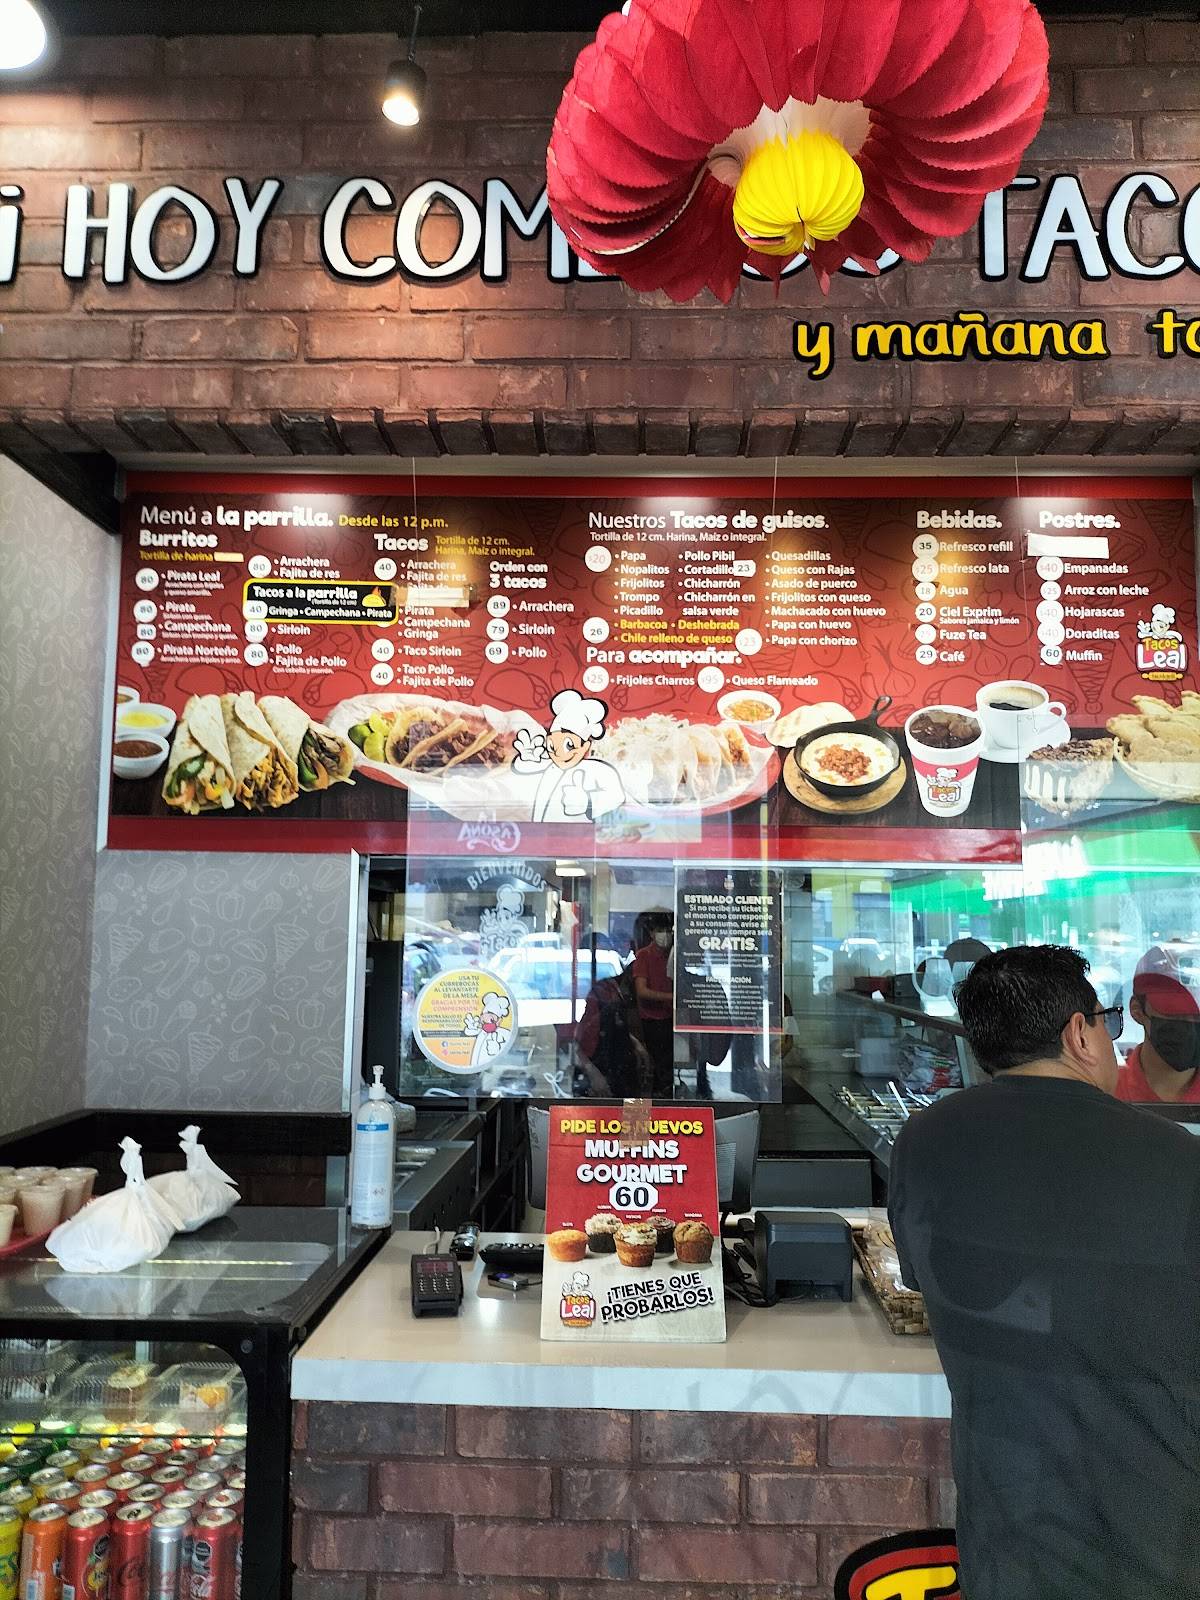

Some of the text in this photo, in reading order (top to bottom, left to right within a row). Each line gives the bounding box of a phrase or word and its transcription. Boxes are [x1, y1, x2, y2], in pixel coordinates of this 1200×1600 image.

[64, 182, 283, 284] HOY
[794, 320, 834, 380] y
[853, 311, 1108, 360] mañana
[140, 506, 448, 531] Menú a la parrilla. Desde las 12 p.m.
[588, 510, 829, 533] Nuestros Tacos de guisos.
[916, 510, 1002, 529] Bebidas.
[1039, 511, 1121, 529] Postres.
[139, 529, 218, 548] Burritos
[374, 533, 428, 551] Tacos
[919, 542, 931, 550] 35
[939, 540, 1013, 552] Refresco refill
[280, 556, 330, 567] Arrachera
[621, 551, 646, 562] Papa
[684, 551, 735, 561] Pollo Pibil
[772, 551, 831, 561] Quesadillas
[407, 559, 456, 571] Arrachera
[490, 561, 548, 573] Orden con
[620, 565, 670, 575] Nopalitos
[684, 565, 734, 575] Cortadillo
[738, 564, 750, 572] 23
[772, 565, 855, 576] Queso con Rajas
[939, 563, 1009, 574] Refresco lata
[1064, 562, 1128, 575] Empanadas
[167, 570, 221, 582] Pirata Leal
[279, 568, 340, 579] Fajita de res
[407, 571, 466, 583] Fajita de res
[490, 574, 547, 588] 3 tacos
[620, 578, 665, 590] Frijolitos
[684, 578, 740, 588] Chicharrón
[772, 579, 857, 590] Asado de puerco
[253, 587, 284, 598] Tacos
[286, 589, 293, 598] a
[295, 587, 306, 598] la
[307, 587, 358, 603] parrilla
[939, 586, 968, 598] Agua
[1065, 585, 1149, 596] Arroz con leche
[620, 592, 660, 604] Trompo
[684, 592, 755, 602] Chicharrón en
[772, 593, 871, 604] Frijolitos con queso
[165, 602, 196, 614] Pirata
[269, 606, 392, 619] Gringa Campechana Pirata
[404, 606, 434, 616] Pirata
[519, 601, 574, 612] Arrachera
[620, 606, 663, 616] Picadillo
[682, 606, 739, 616] salsa verde
[772, 606, 886, 616] Machacado con huevo
[919, 608, 932, 617] 20
[940, 606, 1001, 619] Ciel Exprim
[1065, 606, 1124, 618] Hojarascas
[164, 621, 232, 634] Campechana
[404, 617, 470, 629] Campechana
[620, 620, 739, 630] Barbacoa Deshebrada
[772, 620, 797, 631] Papa
[820, 620, 851, 629] huevo
[277, 625, 310, 636] Sirloin
[404, 629, 438, 640] Gringa
[519, 624, 555, 635] Sirloin
[940, 629, 964, 641] Fuze
[967, 629, 986, 640] Tea
[1065, 628, 1119, 640] Doraditas
[620, 633, 647, 643] Chile
[649, 633, 683, 643] relleno
[686, 633, 699, 643] de
[702, 634, 732, 645] queso
[772, 635, 857, 646] Papa con chorizo
[1142, 639, 1179, 651] Tacos
[163, 644, 193, 656] Pirata
[276, 645, 302, 655] Pollo
[404, 645, 462, 656] Taco Sirloin
[519, 647, 547, 658] Pollo
[919, 650, 932, 658] 29
[1045, 649, 1059, 658] 60
[1065, 650, 1102, 661] Muffin
[1137, 643, 1186, 669] Leal
[275, 657, 347, 668] Fajita de Pollo
[587, 647, 742, 668] Para acompañar.
[940, 651, 964, 662] Café
[403, 664, 454, 674] Taco Pollo
[403, 675, 474, 687] Fajita de Pollo
[617, 674, 694, 686] Frijoles Charros
[732, 675, 818, 686] Queso Flameado
[928, 787, 961, 802] Leal
[467, 860, 547, 892] BIENVENIDOS
[684, 895, 773, 905] ESTIMADO CLIENTE
[699, 937, 759, 951] GRATIS.
[561, 1120, 596, 1134] PIDE
[585, 1140, 680, 1159] MUFFINS
[577, 1164, 688, 1184] GOURMET
[616, 1186, 650, 1208] 60
[607, 1271, 702, 1304] ¡TIENES QUE
[561, 1299, 595, 1319] Leal
[601, 1286, 715, 1323] PROBARLOS!
